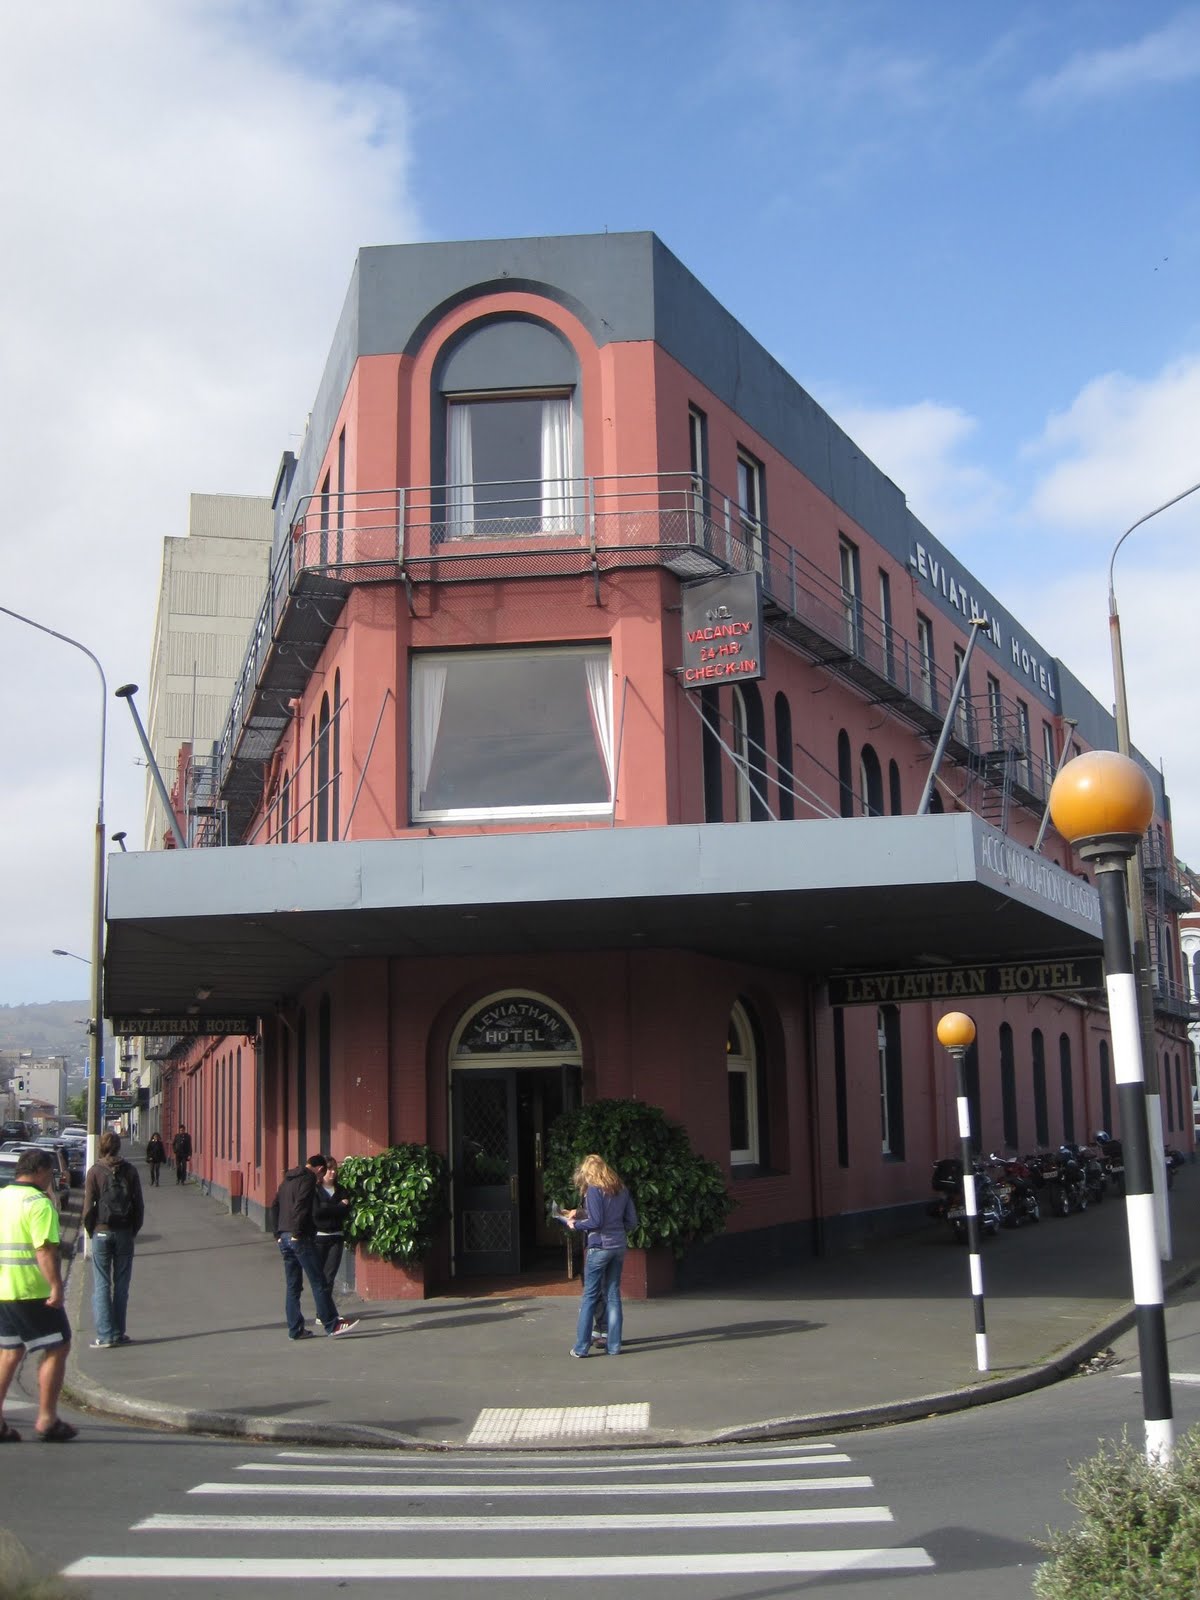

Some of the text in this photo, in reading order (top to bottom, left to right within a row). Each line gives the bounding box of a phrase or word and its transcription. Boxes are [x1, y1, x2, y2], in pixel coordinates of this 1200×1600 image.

[687, 622, 751, 643] VACANCY
[909, 542, 1056, 700] EVIATHAN HOTEL
[685, 660, 756, 681] CHECK-IN
[847, 963, 1081, 1002] LEVIATHAN HOTEL
[119, 1019, 250, 1033] LEVIATHAN HOTEL
[474, 1004, 560, 1043] LEVIATHAN HOTEL
